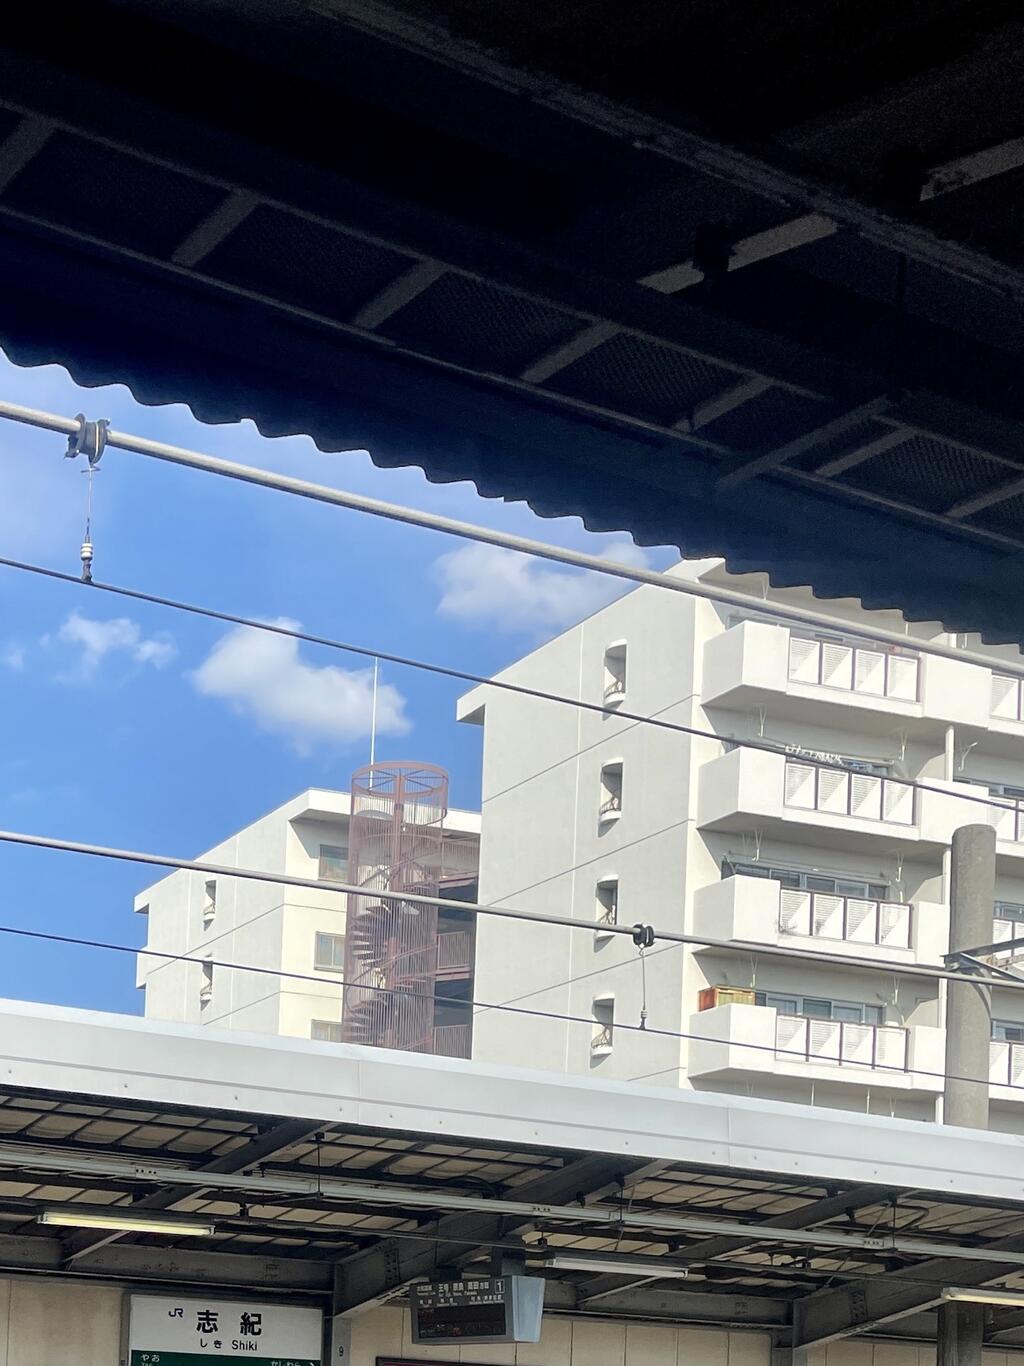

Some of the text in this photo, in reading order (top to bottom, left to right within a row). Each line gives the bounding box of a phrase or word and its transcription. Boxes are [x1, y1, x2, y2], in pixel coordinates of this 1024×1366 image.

[168, 1308, 262, 1336] JR 志紀
[200, 1338, 258, 1351] しき Shiki
[141, 1353, 160, 1363] やお
